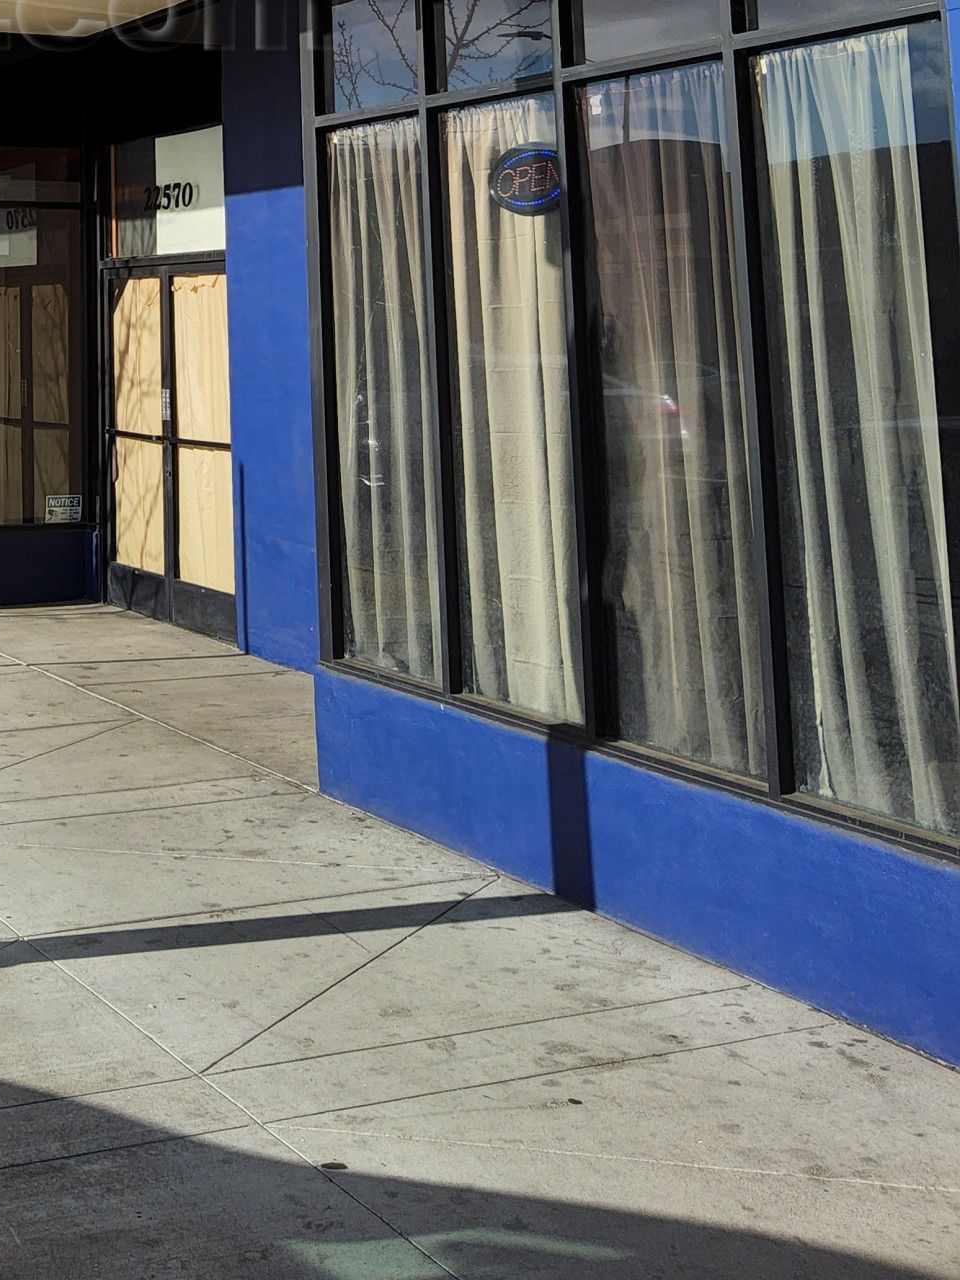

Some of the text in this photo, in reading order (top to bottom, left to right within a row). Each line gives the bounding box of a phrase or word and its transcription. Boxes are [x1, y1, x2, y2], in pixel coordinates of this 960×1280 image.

[497, 160, 559, 198] OPEN
[144, 182, 194, 212] 22570
[49, 497, 80, 507] NOTICE
